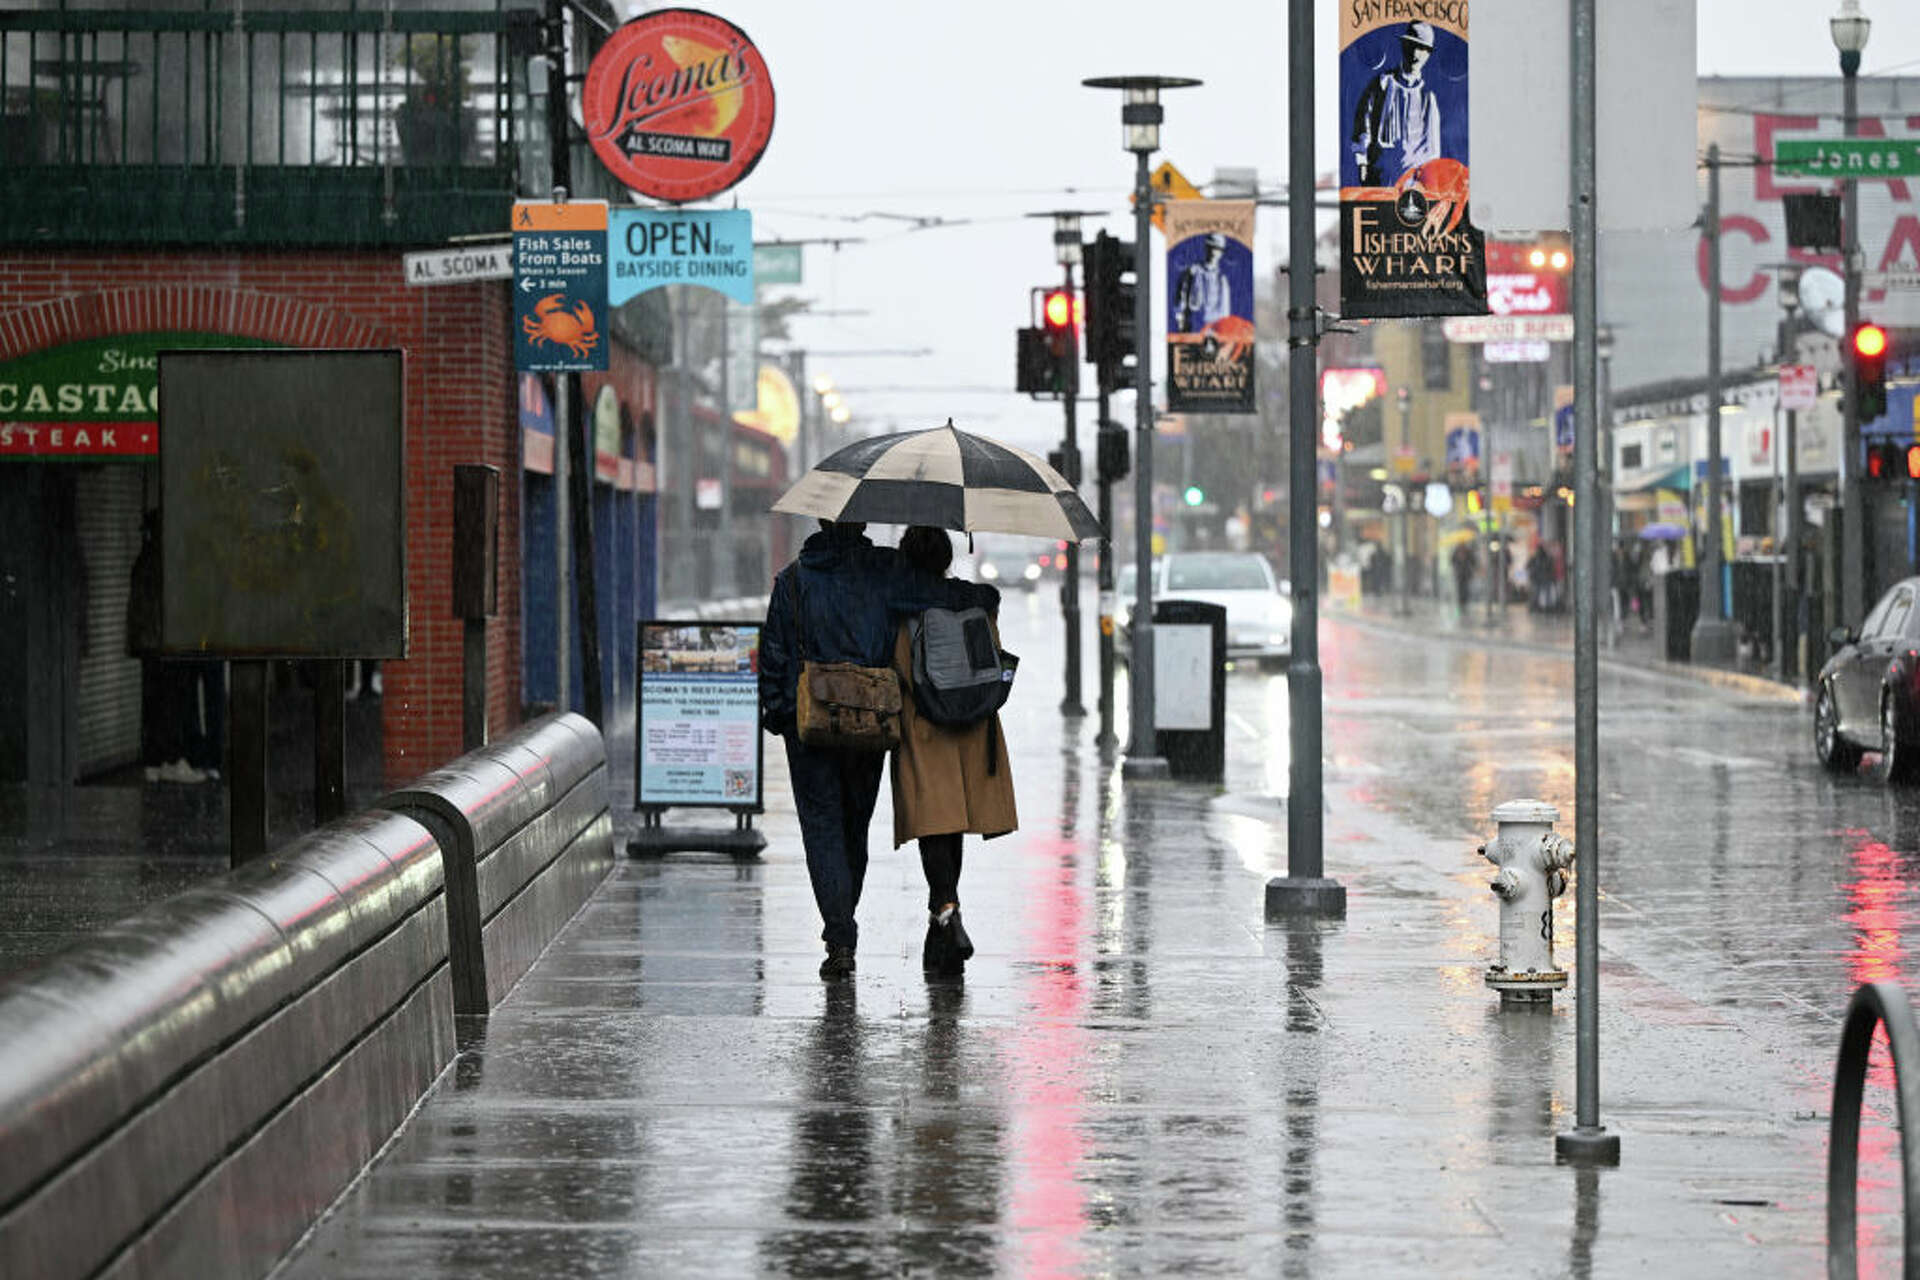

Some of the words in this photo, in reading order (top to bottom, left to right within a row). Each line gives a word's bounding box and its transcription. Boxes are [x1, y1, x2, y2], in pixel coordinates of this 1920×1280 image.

[1352, 0, 1380, 28] SAN
[1384, 0, 1469, 30] FRANCISCO
[596, 38, 749, 140] Scoma's
[627, 134, 643, 151] AL
[648, 136, 695, 154] SCOMA
[697, 141, 727, 158] WAY
[1808, 147, 1901, 169] Jones
[626, 222, 711, 256] OPEN
[715, 240, 734, 254] for
[1353, 207, 1472, 254] FISHERMAN'S
[519, 237, 549, 250] Fish
[552, 237, 592, 251] Sales
[414, 261, 434, 278] AL
[442, 254, 498, 275] SCOMA
[519, 252, 556, 265] From
[561, 252, 602, 265] Boats
[616, 261, 683, 278] BAYSIDE
[688, 261, 747, 277] DINING
[1353, 255, 1474, 275] WHARF
[1, 428, 117, 446] STEAK
